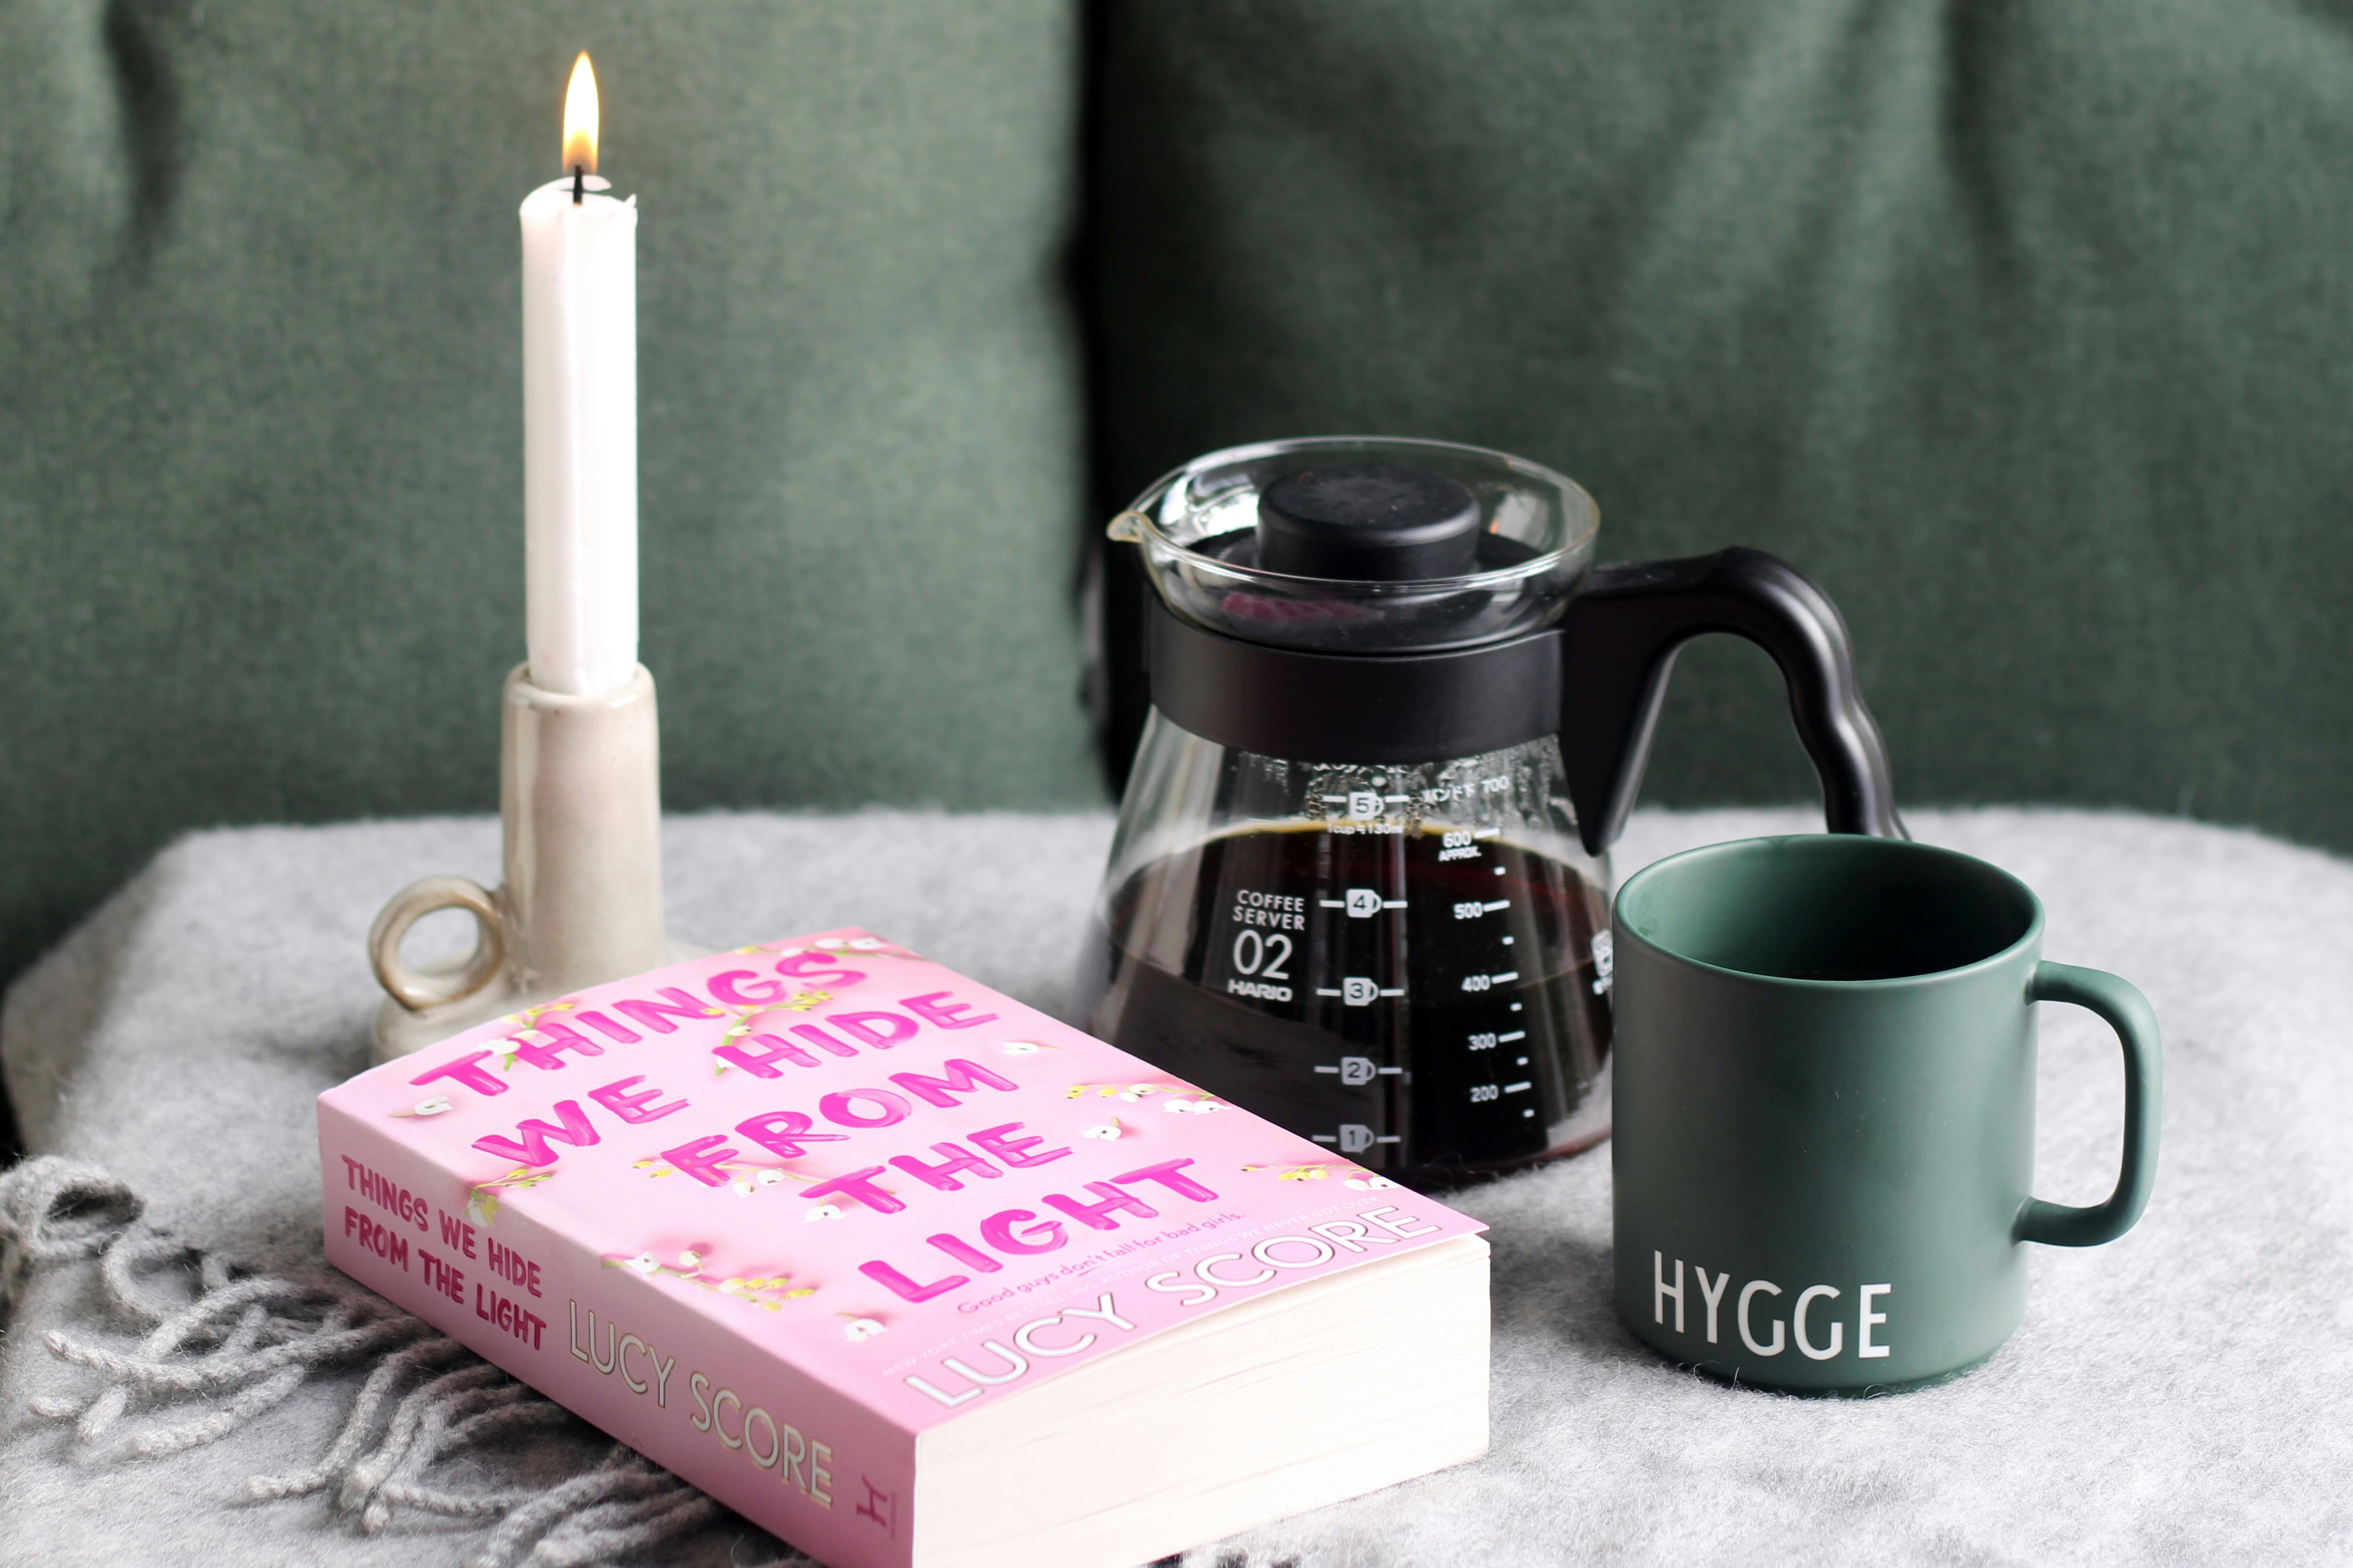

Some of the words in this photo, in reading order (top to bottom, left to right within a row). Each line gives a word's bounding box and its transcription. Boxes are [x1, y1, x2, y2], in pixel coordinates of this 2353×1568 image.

[1481, 775, 1509, 793] 700
[1355, 796, 1371, 814] 5
[1442, 830, 1472, 848] 600
[1438, 845, 1482, 862] APPROX.
[1237, 888, 1305, 912] COFFEE
[1353, 895, 1366, 910] 4
[1453, 901, 1484, 920] 500
[1232, 905, 1305, 931] SERVER
[1233, 929, 1293, 980] 02
[1227, 978, 1293, 1002] HARIO
[1350, 982, 1364, 999] 3
[1461, 974, 1491, 992] 400
[409, 952, 866, 1096] THINGS
[1467, 1032, 1496, 1051] 300
[472, 1074, 691, 1167] WE
[712, 991, 1000, 1079] HIDE
[1347, 1061, 1361, 1078] 2
[1470, 1084, 1499, 1102] 200
[661, 1058, 1019, 1188] FROM
[799, 1122, 1074, 1214] THE
[341, 1154, 429, 1232] THINGS
[438, 1208, 477, 1260] WE
[488, 1236, 542, 1298] HIDE
[857, 1158, 1219, 1303] LIGHT
[957, 1287, 1015, 1313] Good
[1017, 1271, 1060, 1294] guys
[1059, 1253, 1103, 1277] don't
[1103, 1241, 1136, 1260] fall
[1135, 1235, 1164, 1249] for
[1163, 1223, 1200, 1239] bad
[1201, 1211, 1247, 1231] girls.
[961, 1318, 1004, 1341] TIMES
[1101, 1259, 1161, 1286] AUTHOR
[1162, 1251, 1182, 1263] OF
[1183, 1235, 1237, 1256] THINGS
[1237, 1226, 1263, 1240] WE
[1263, 1213, 1309, 1233] NEVER
[1313, 1205, 1340, 1219] GOT
[1342, 1196, 1381, 1210] OVER
[344, 1205, 408, 1273] FROM
[417, 1248, 465, 1305] THE
[476, 1283, 547, 1351] LIGHT
[902, 1291, 1136, 1409] LUCY
[1144, 1205, 1442, 1306] SCORE
[1654, 1250, 1892, 1361] HYGGE
[569, 1299, 676, 1410] LUCY
[689, 1370, 833, 1510] SCORE
